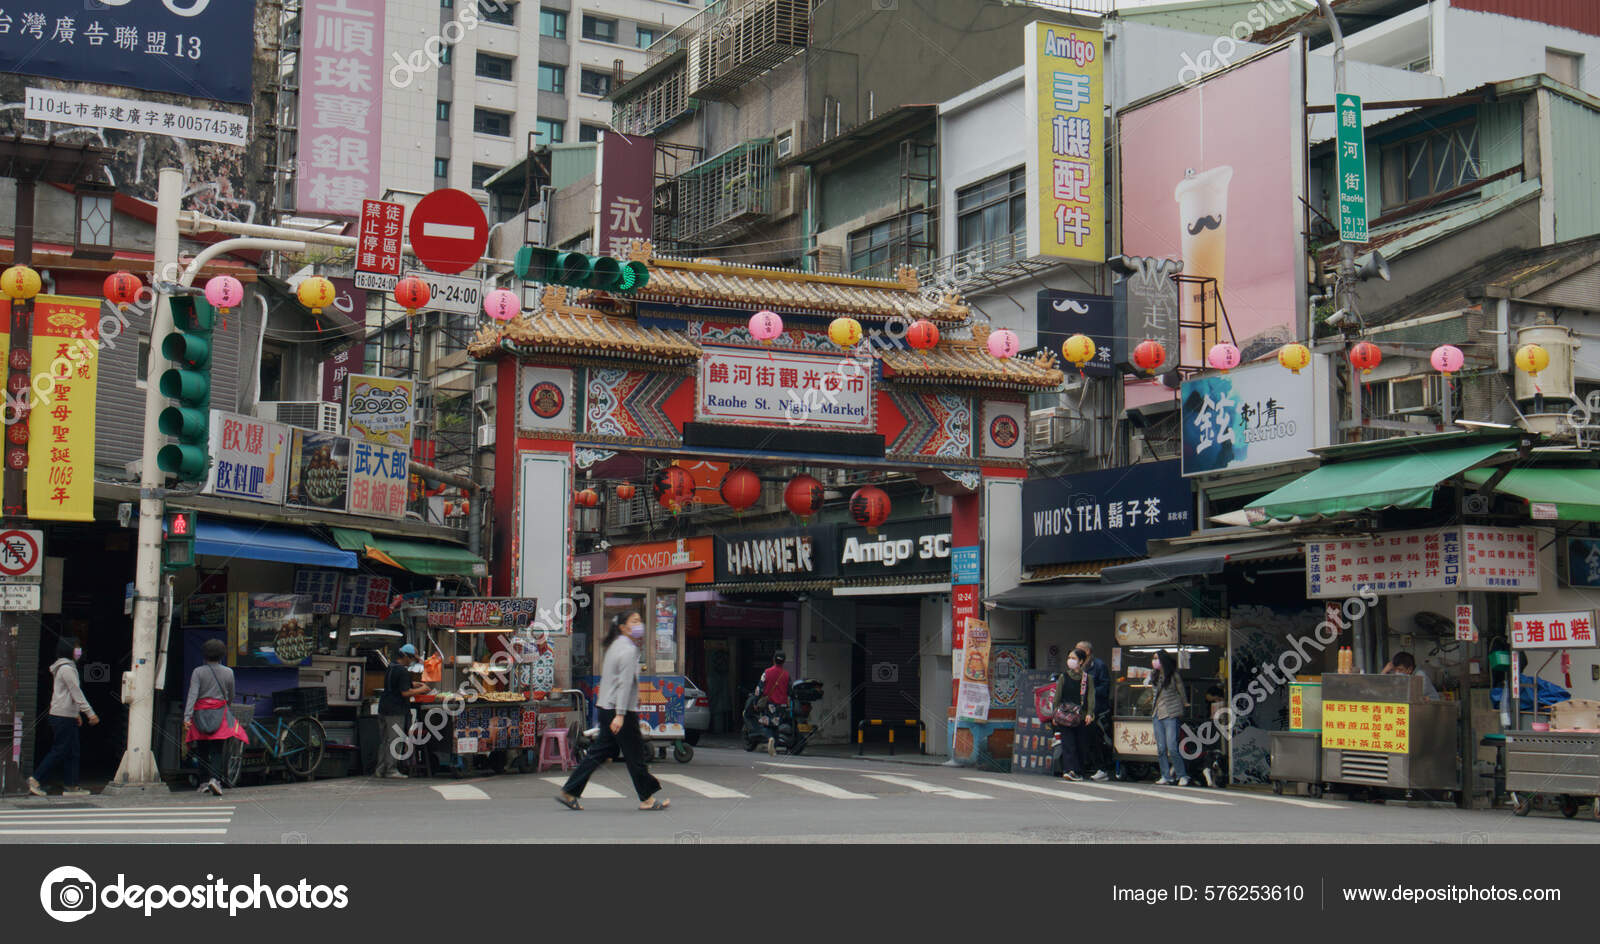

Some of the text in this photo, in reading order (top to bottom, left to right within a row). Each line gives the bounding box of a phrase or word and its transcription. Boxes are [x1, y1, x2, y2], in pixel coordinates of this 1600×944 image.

[1044, 30, 1095, 67] Amigo
[28, 96, 244, 140] 110北市都建廣字第005745號
[1052, 71, 1090, 247] 手機配件
[1342, 110, 1360, 191] 饒河街
[1341, 193, 1363, 203] RaoHe
[361, 202, 381, 268] 禁止停車
[381, 205, 401, 270] 徒步區內
[709, 362, 865, 393] 饒河街觀光夜市
[708, 394, 865, 417] Raohe St. Night Market
[1240, 397, 1285, 428] 刺青
[1243, 423, 1296, 443] TATTOO
[217, 460, 264, 494] 飲料吧
[355, 444, 407, 480] 武大郎
[353, 478, 406, 515] 胡椒餅
[1034, 507, 1072, 537] WHO'S
[1077, 504, 1102, 531] TEA
[727, 536, 813, 576] HAMMER
[843, 534, 951, 566] Amigo 3C
